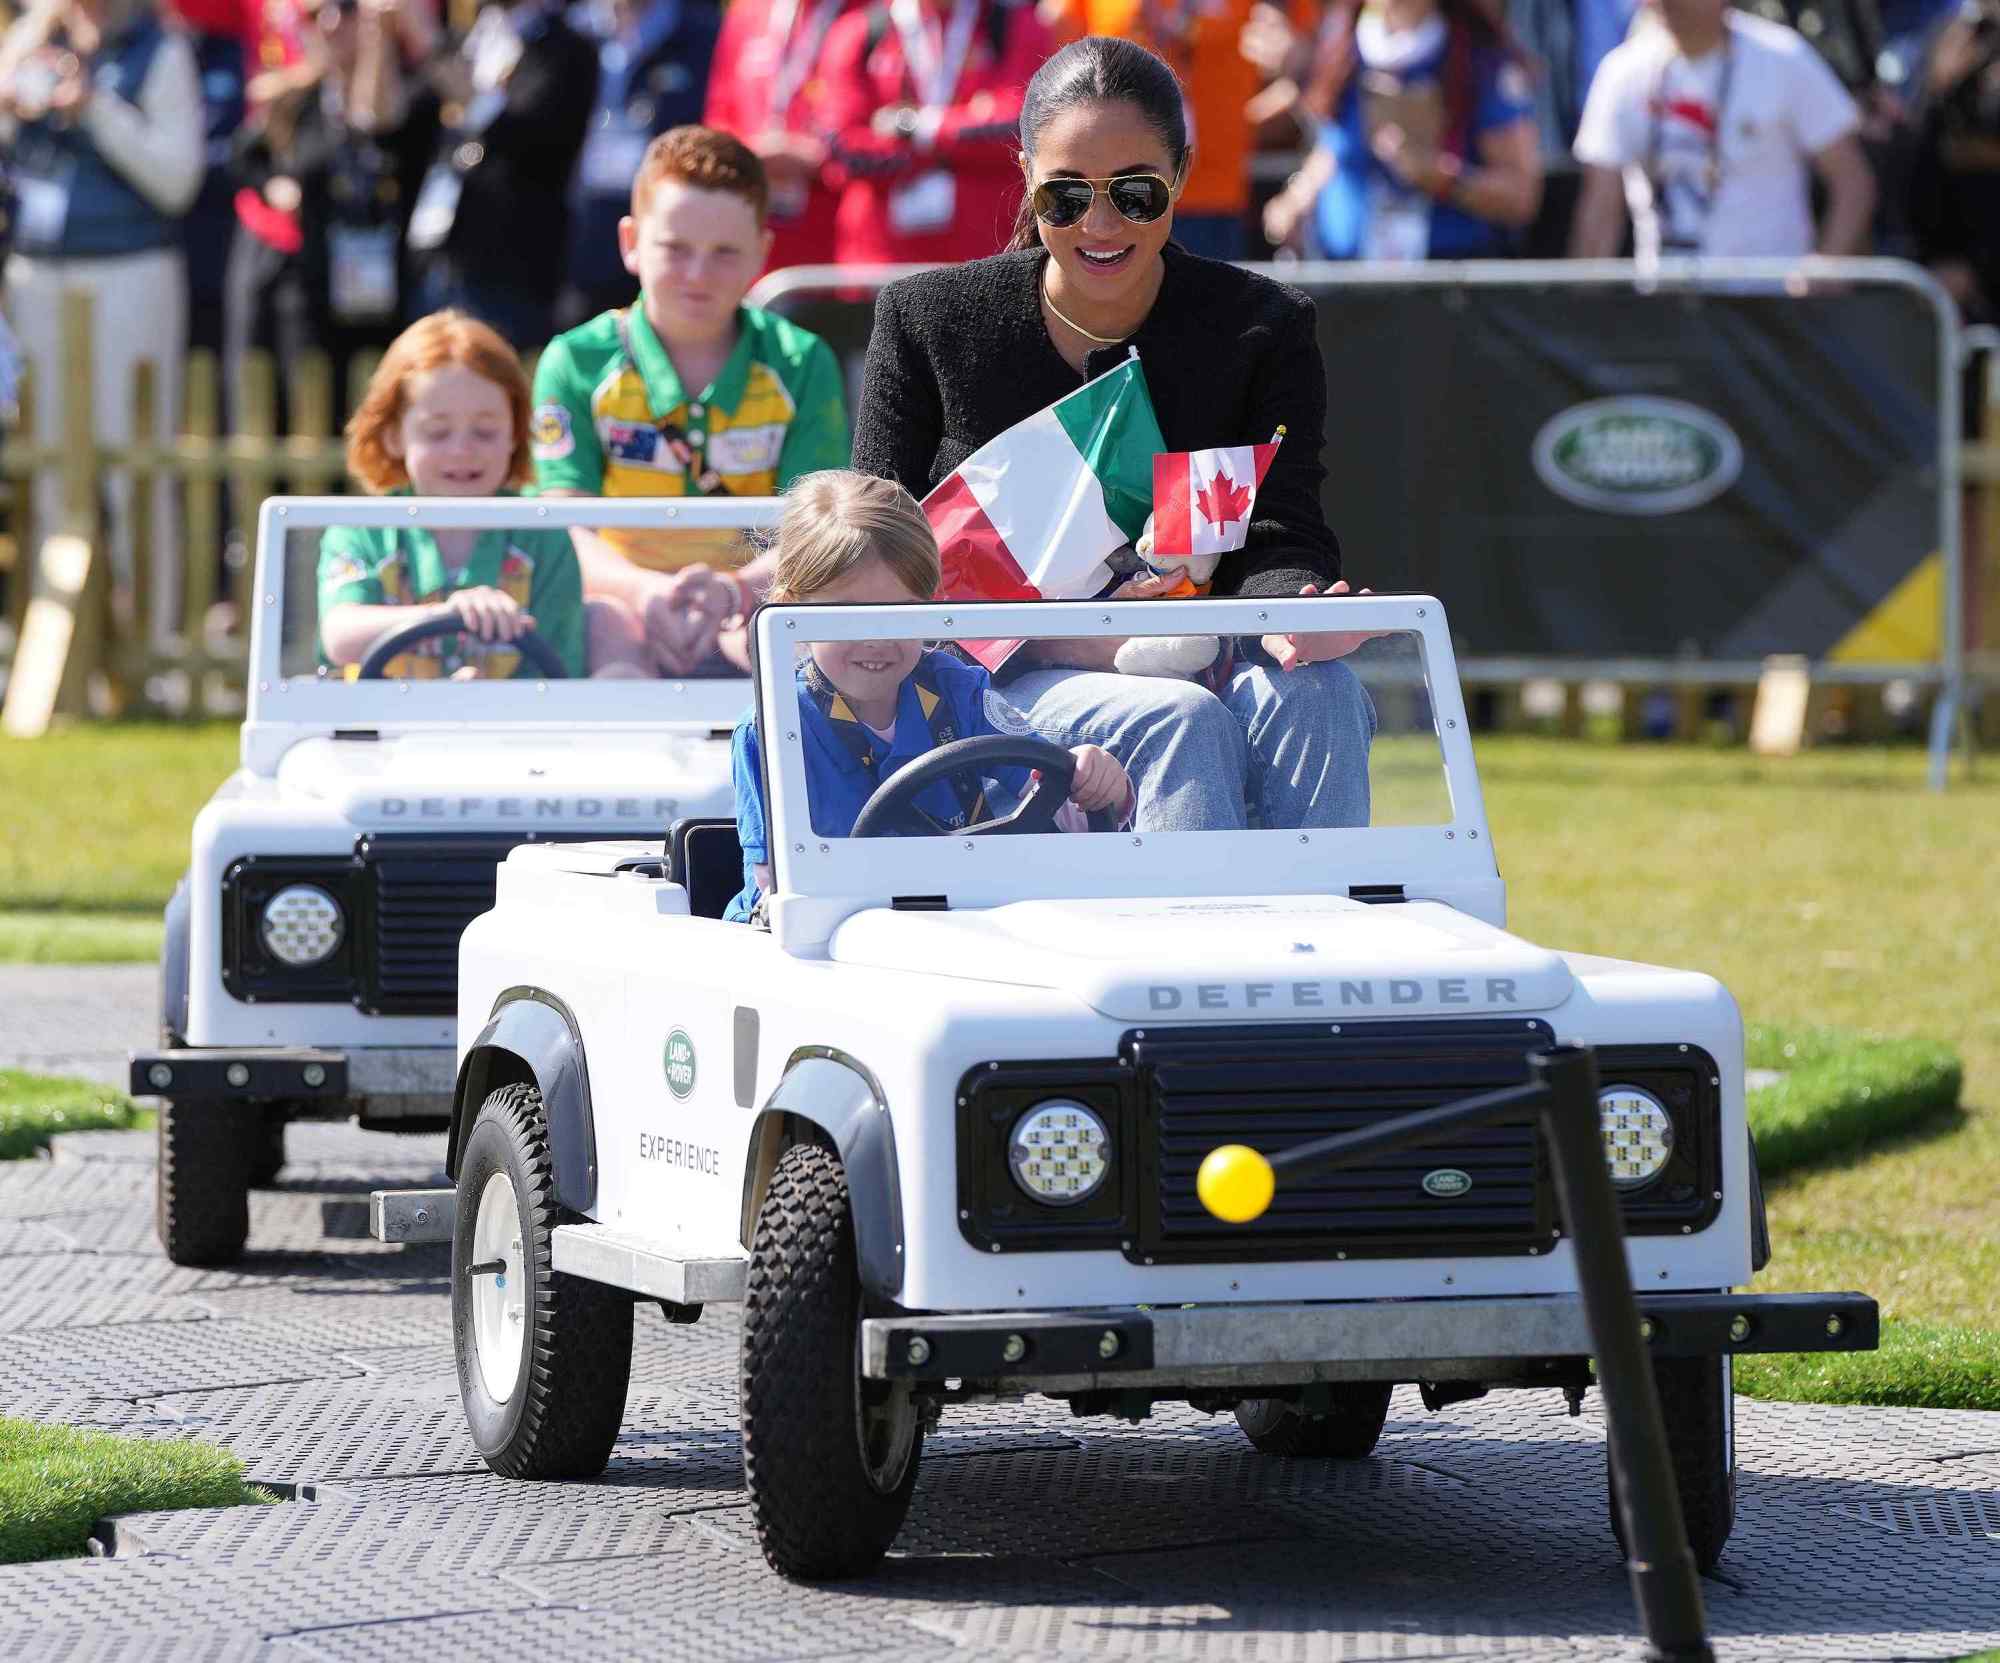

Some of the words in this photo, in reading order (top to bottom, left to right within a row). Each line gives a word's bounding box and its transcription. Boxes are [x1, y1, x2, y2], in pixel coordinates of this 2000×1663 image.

[381, 797, 680, 817] DEFENDER
[1148, 977, 1518, 1011] DEFENDER
[640, 1132, 719, 1176] EXPERIENCE
